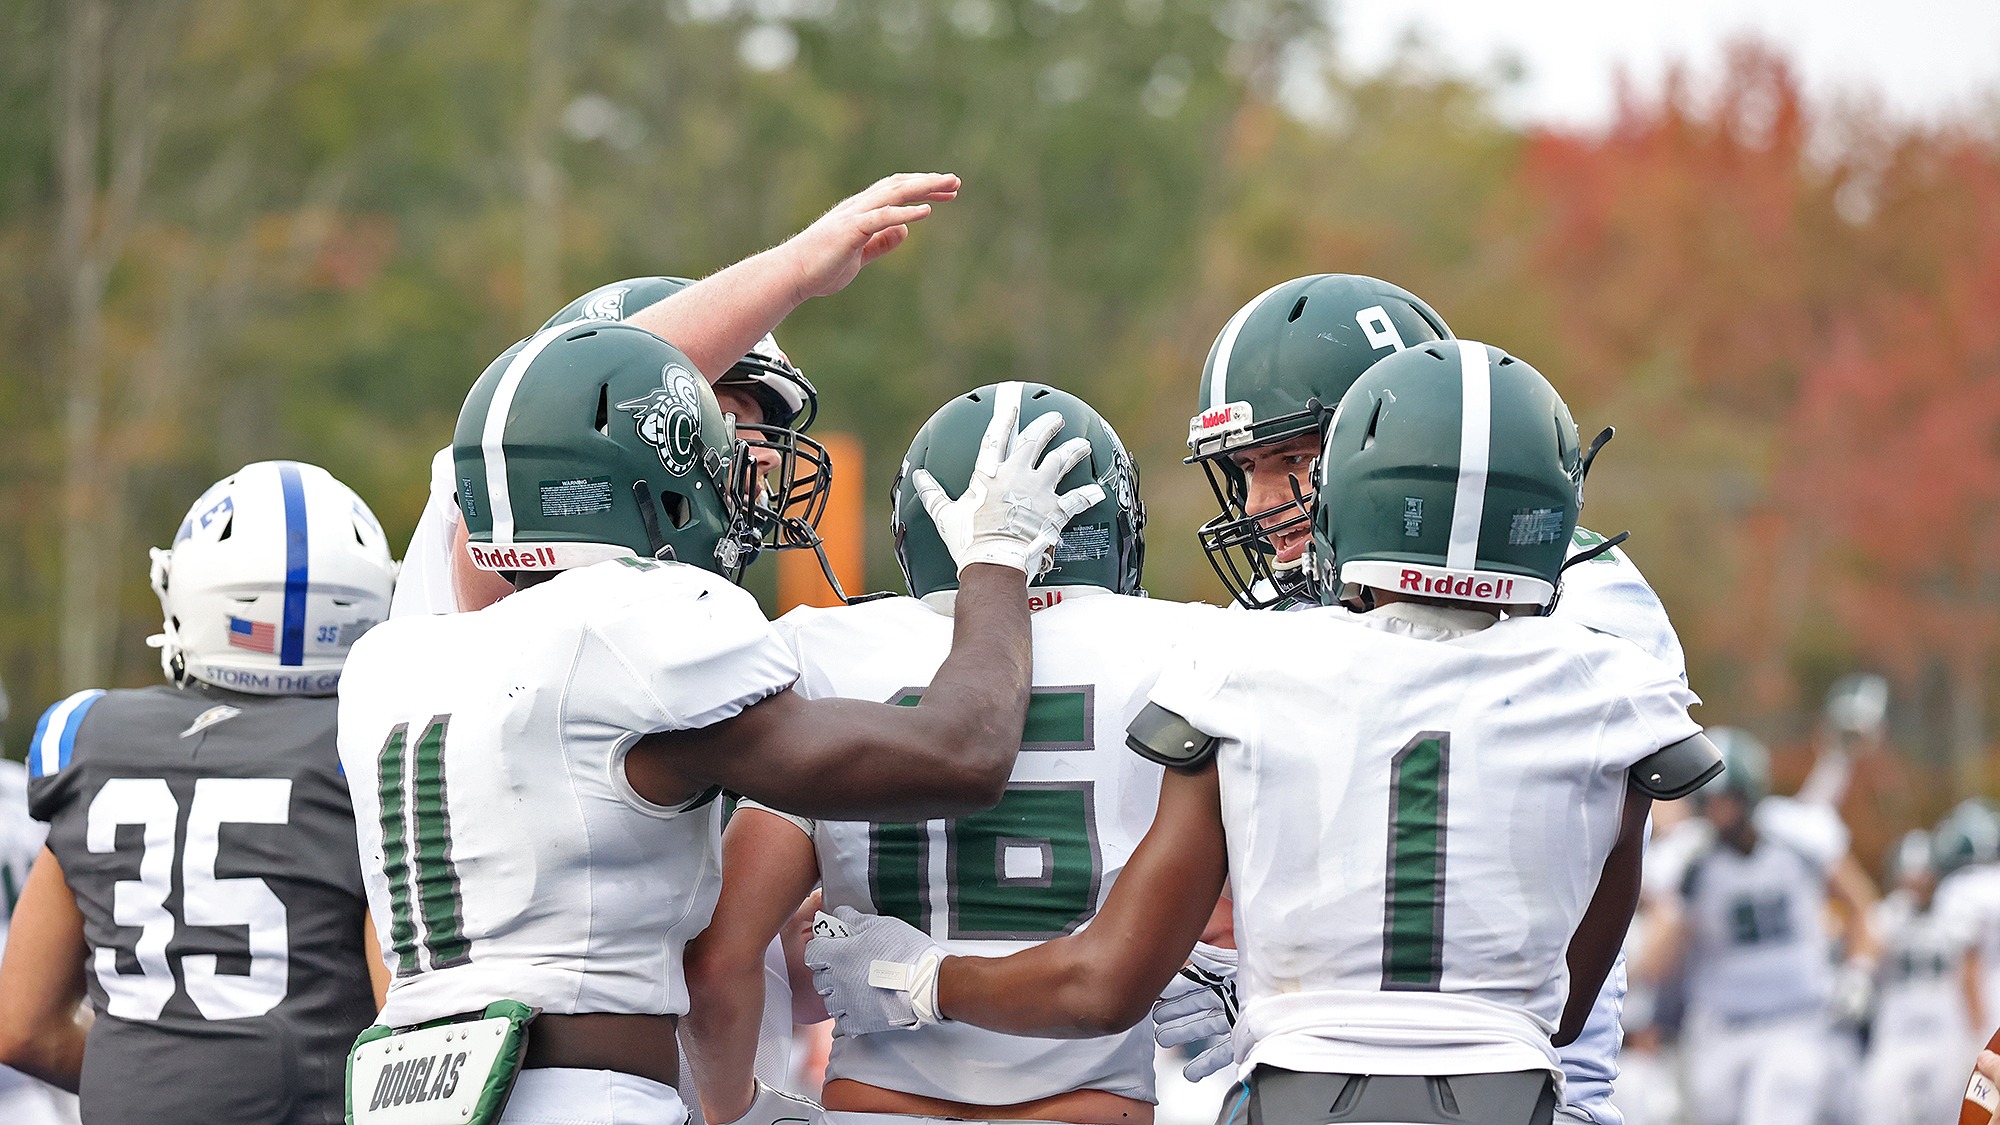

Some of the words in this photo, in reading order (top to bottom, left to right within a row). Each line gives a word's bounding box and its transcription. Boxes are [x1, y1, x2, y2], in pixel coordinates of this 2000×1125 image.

[1355, 304, 1408, 353] 9
[200, 495, 234, 530] E
[471, 546, 556, 568] Riddell
[1399, 568, 1514, 600] Riddell
[316, 625, 337, 643] 35
[206, 666, 270, 688] STORM
[275, 675, 312, 691] THE
[377, 712, 473, 979] 11
[1380, 730, 1451, 992] 1
[87, 778, 293, 1021] 35
[368, 1051, 468, 1113] DOUGLAS
